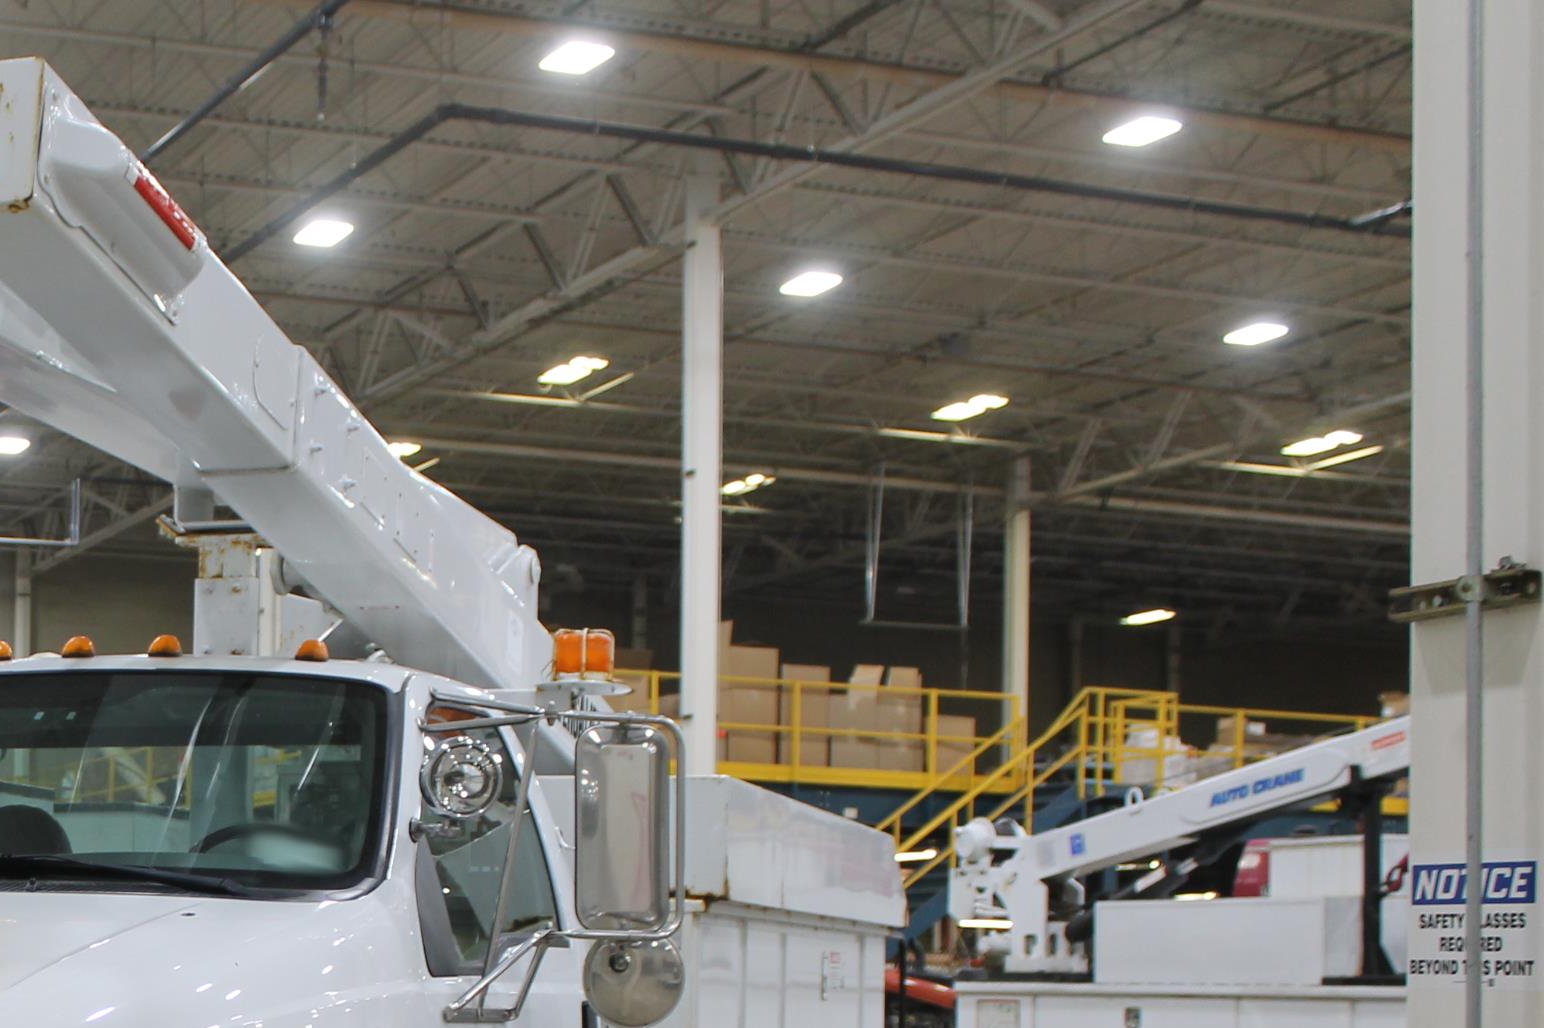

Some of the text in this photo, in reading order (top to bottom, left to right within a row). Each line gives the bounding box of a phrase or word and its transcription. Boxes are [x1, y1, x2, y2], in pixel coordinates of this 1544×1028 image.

[1210, 768, 1305, 806] AUTO CRANE
[1419, 913, 1465, 929] SAFETY
[1440, 936, 1503, 952] REQRED
[1410, 959, 1459, 975] BEYOND
[1495, 960, 1535, 976] POINT
